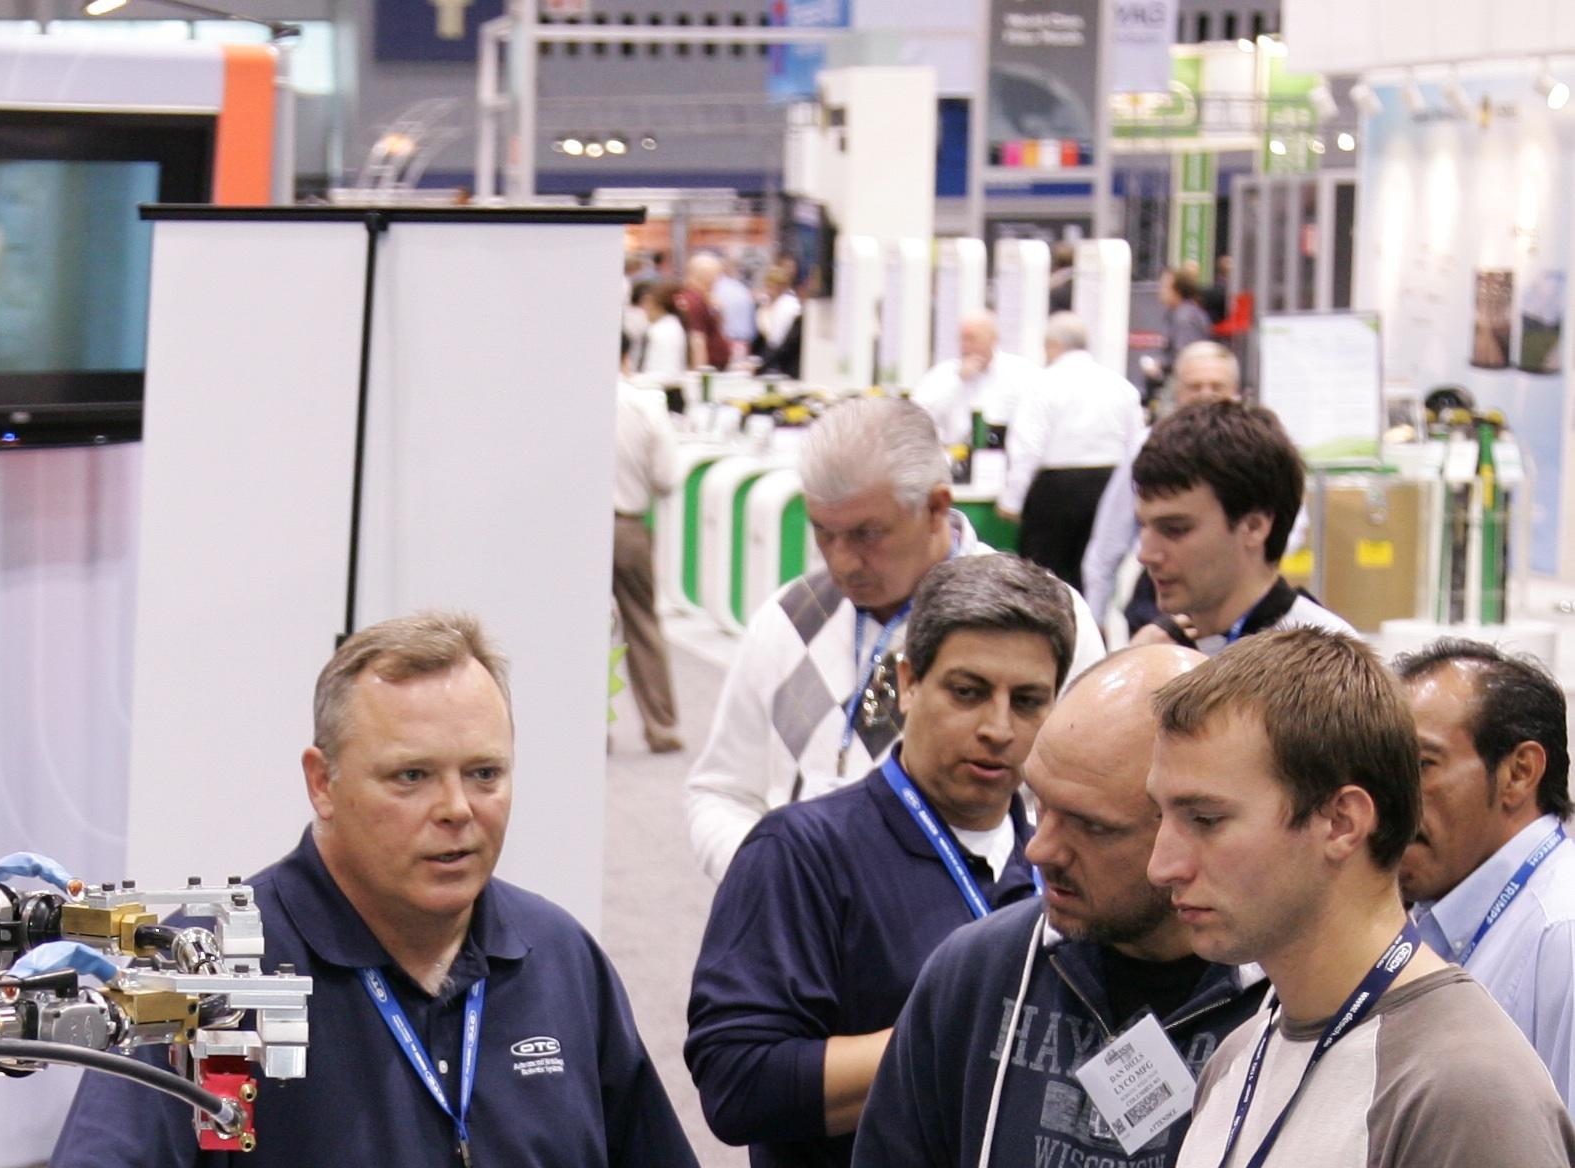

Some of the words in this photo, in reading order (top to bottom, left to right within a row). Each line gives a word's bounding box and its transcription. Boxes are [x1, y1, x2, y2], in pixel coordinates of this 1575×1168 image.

[1487, 881, 1520, 924] TRUMPF
[1387, 948, 1410, 973] DESCH
[520, 1041, 558, 1053] OTC
[1113, 1075, 1136, 1095] LYCO
[1135, 1061, 1154, 1078] MFG
